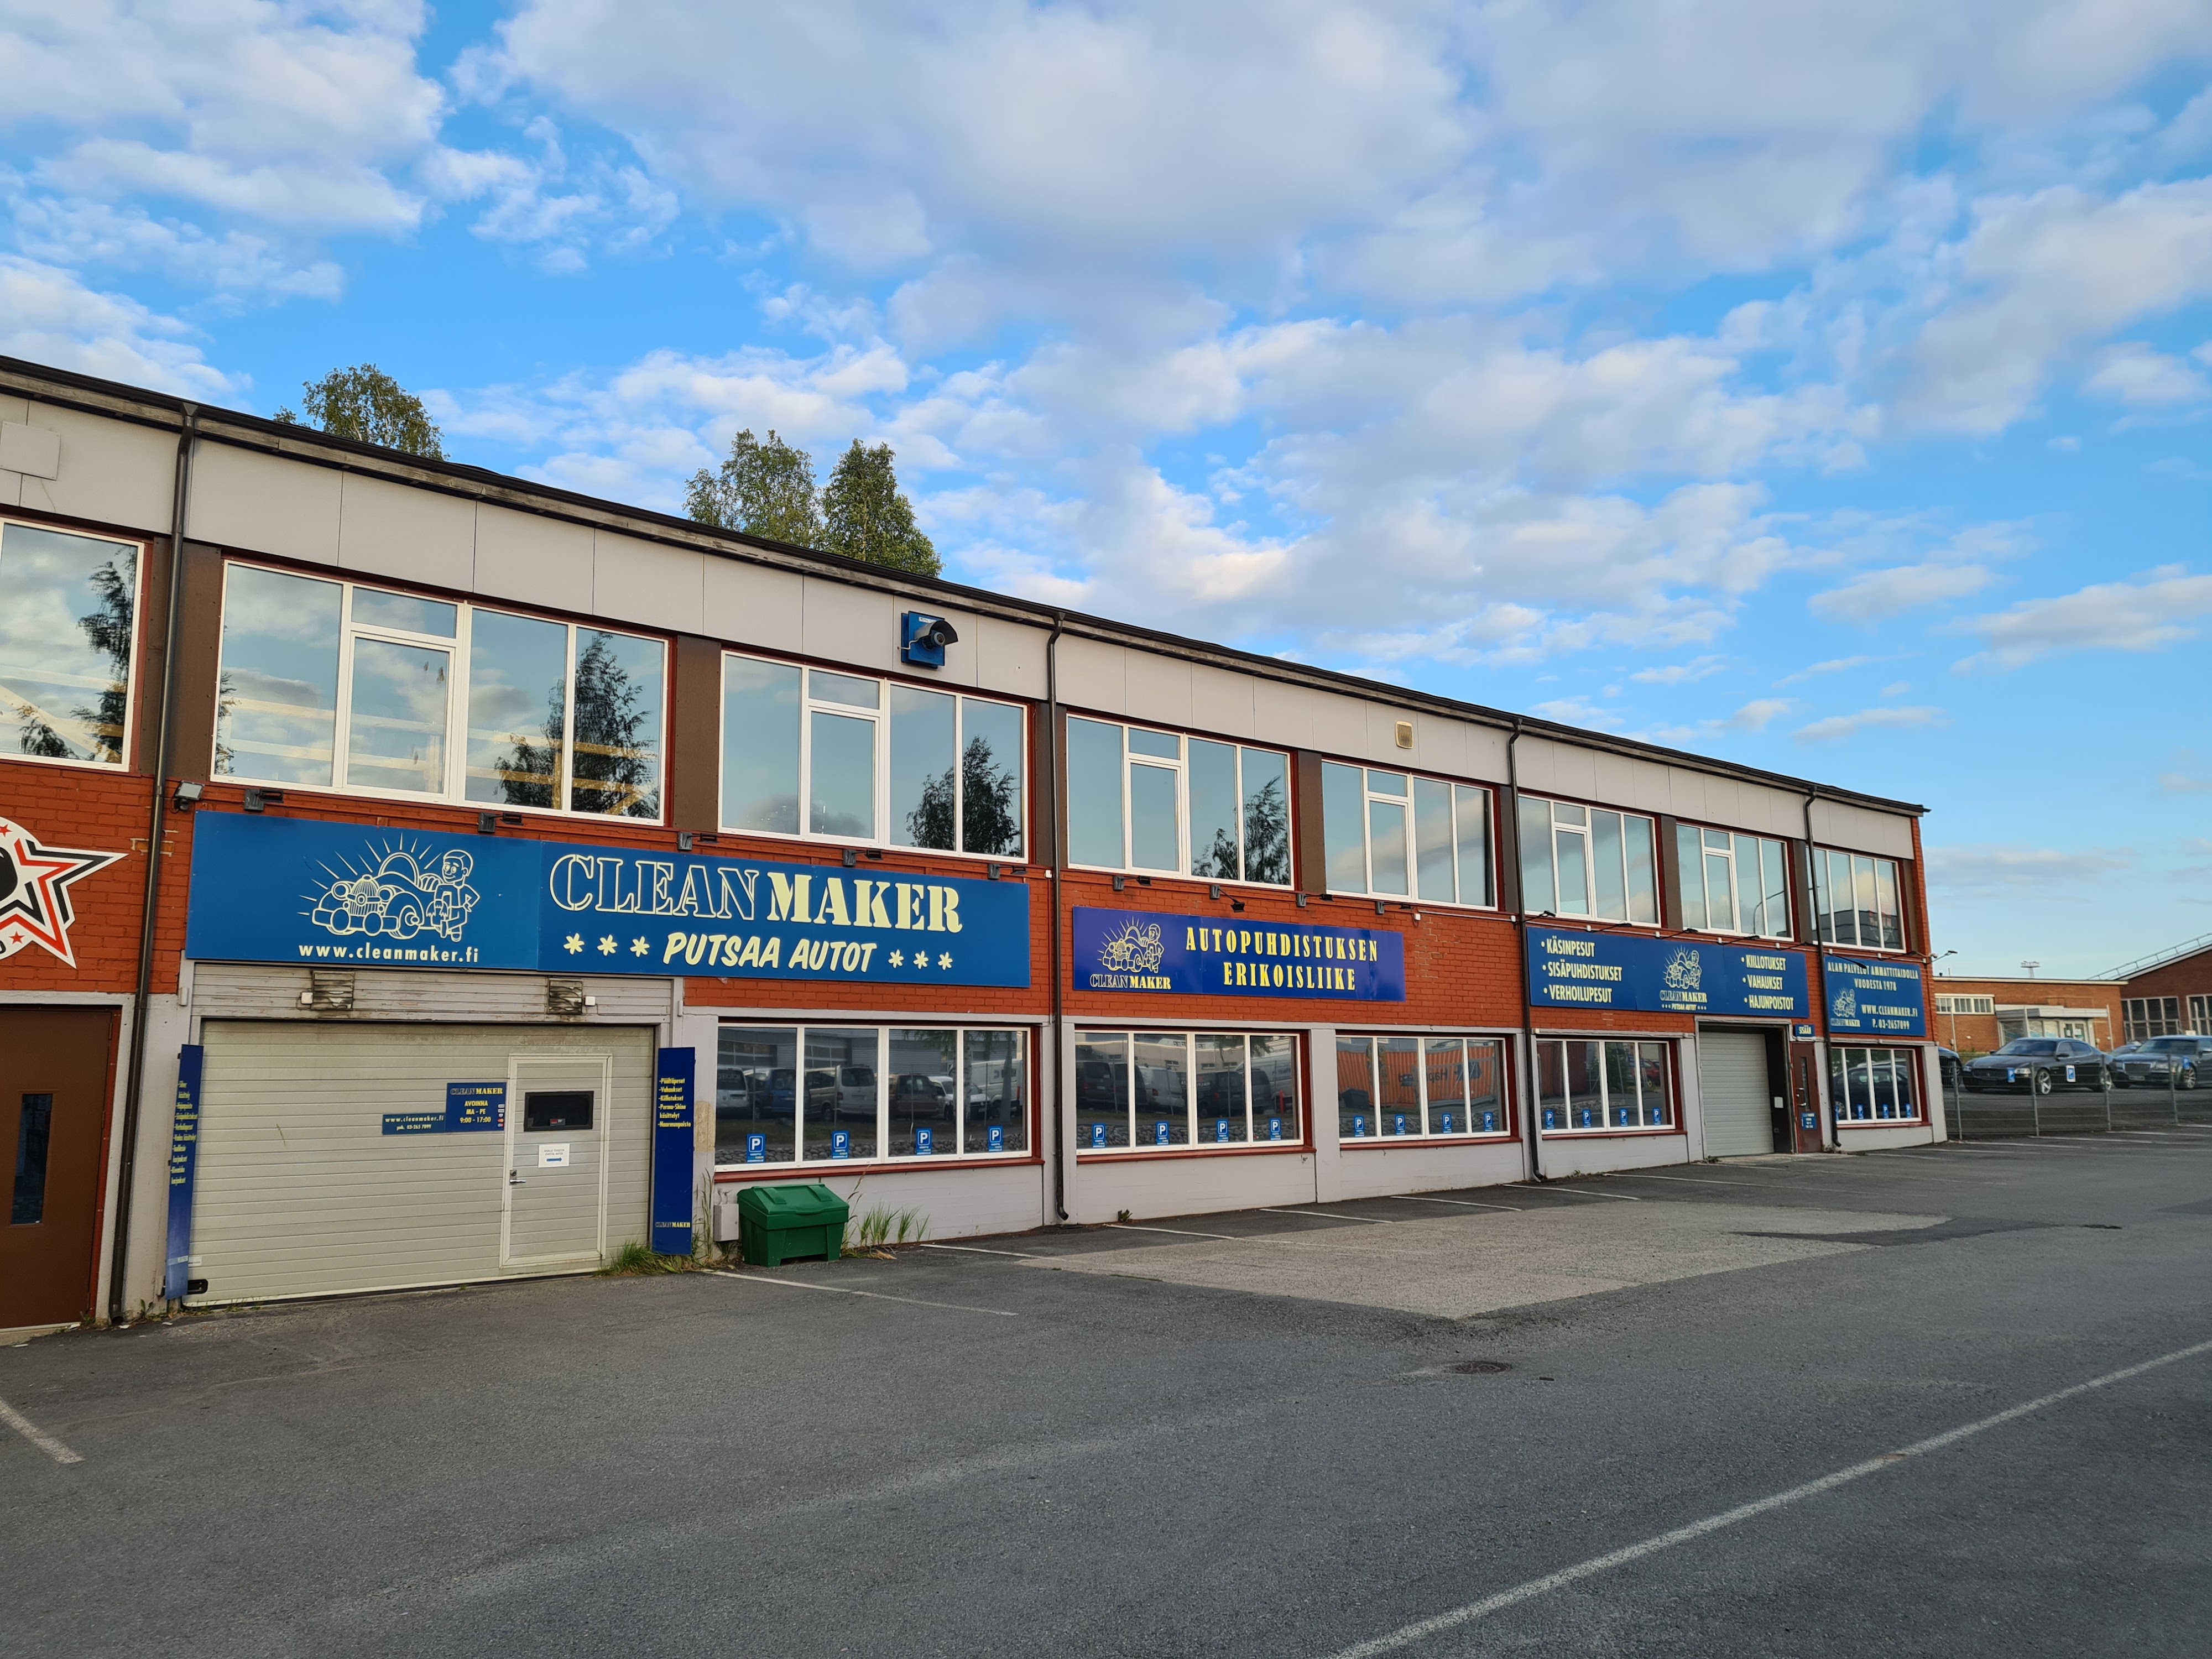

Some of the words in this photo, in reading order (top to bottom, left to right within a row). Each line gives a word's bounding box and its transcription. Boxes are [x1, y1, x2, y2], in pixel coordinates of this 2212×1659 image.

[298, 942, 478, 964] www.cleanmaker.fi
[662, 932, 780, 968] PUTSAA
[788, 938, 878, 973] AUTOT
[1186, 927, 1378, 962] AUTOPUHDISTUKSEN
[1546, 935, 1595, 958] KÄSINPESUT
[1547, 958, 1623, 982] SISÄPUHDISTUKSET
[1746, 954, 1786, 972] KIILLOTUKSET
[1223, 962, 1355, 990] ERIKOISLIIKE
[1747, 975, 1783, 990] VAHAUKSET
[1854, 978, 1883, 990] VUODESTA
[1548, 984, 1613, 1003] VERHOILUPESUT
[1749, 997, 1794, 1011] HAJUNPOISTOT
[385, 1115, 444, 1123] www.cleanmaker.fi
[752, 1139, 760, 1150] P
[837, 1135, 844, 1146] P
[921, 1133, 927, 1143] P
